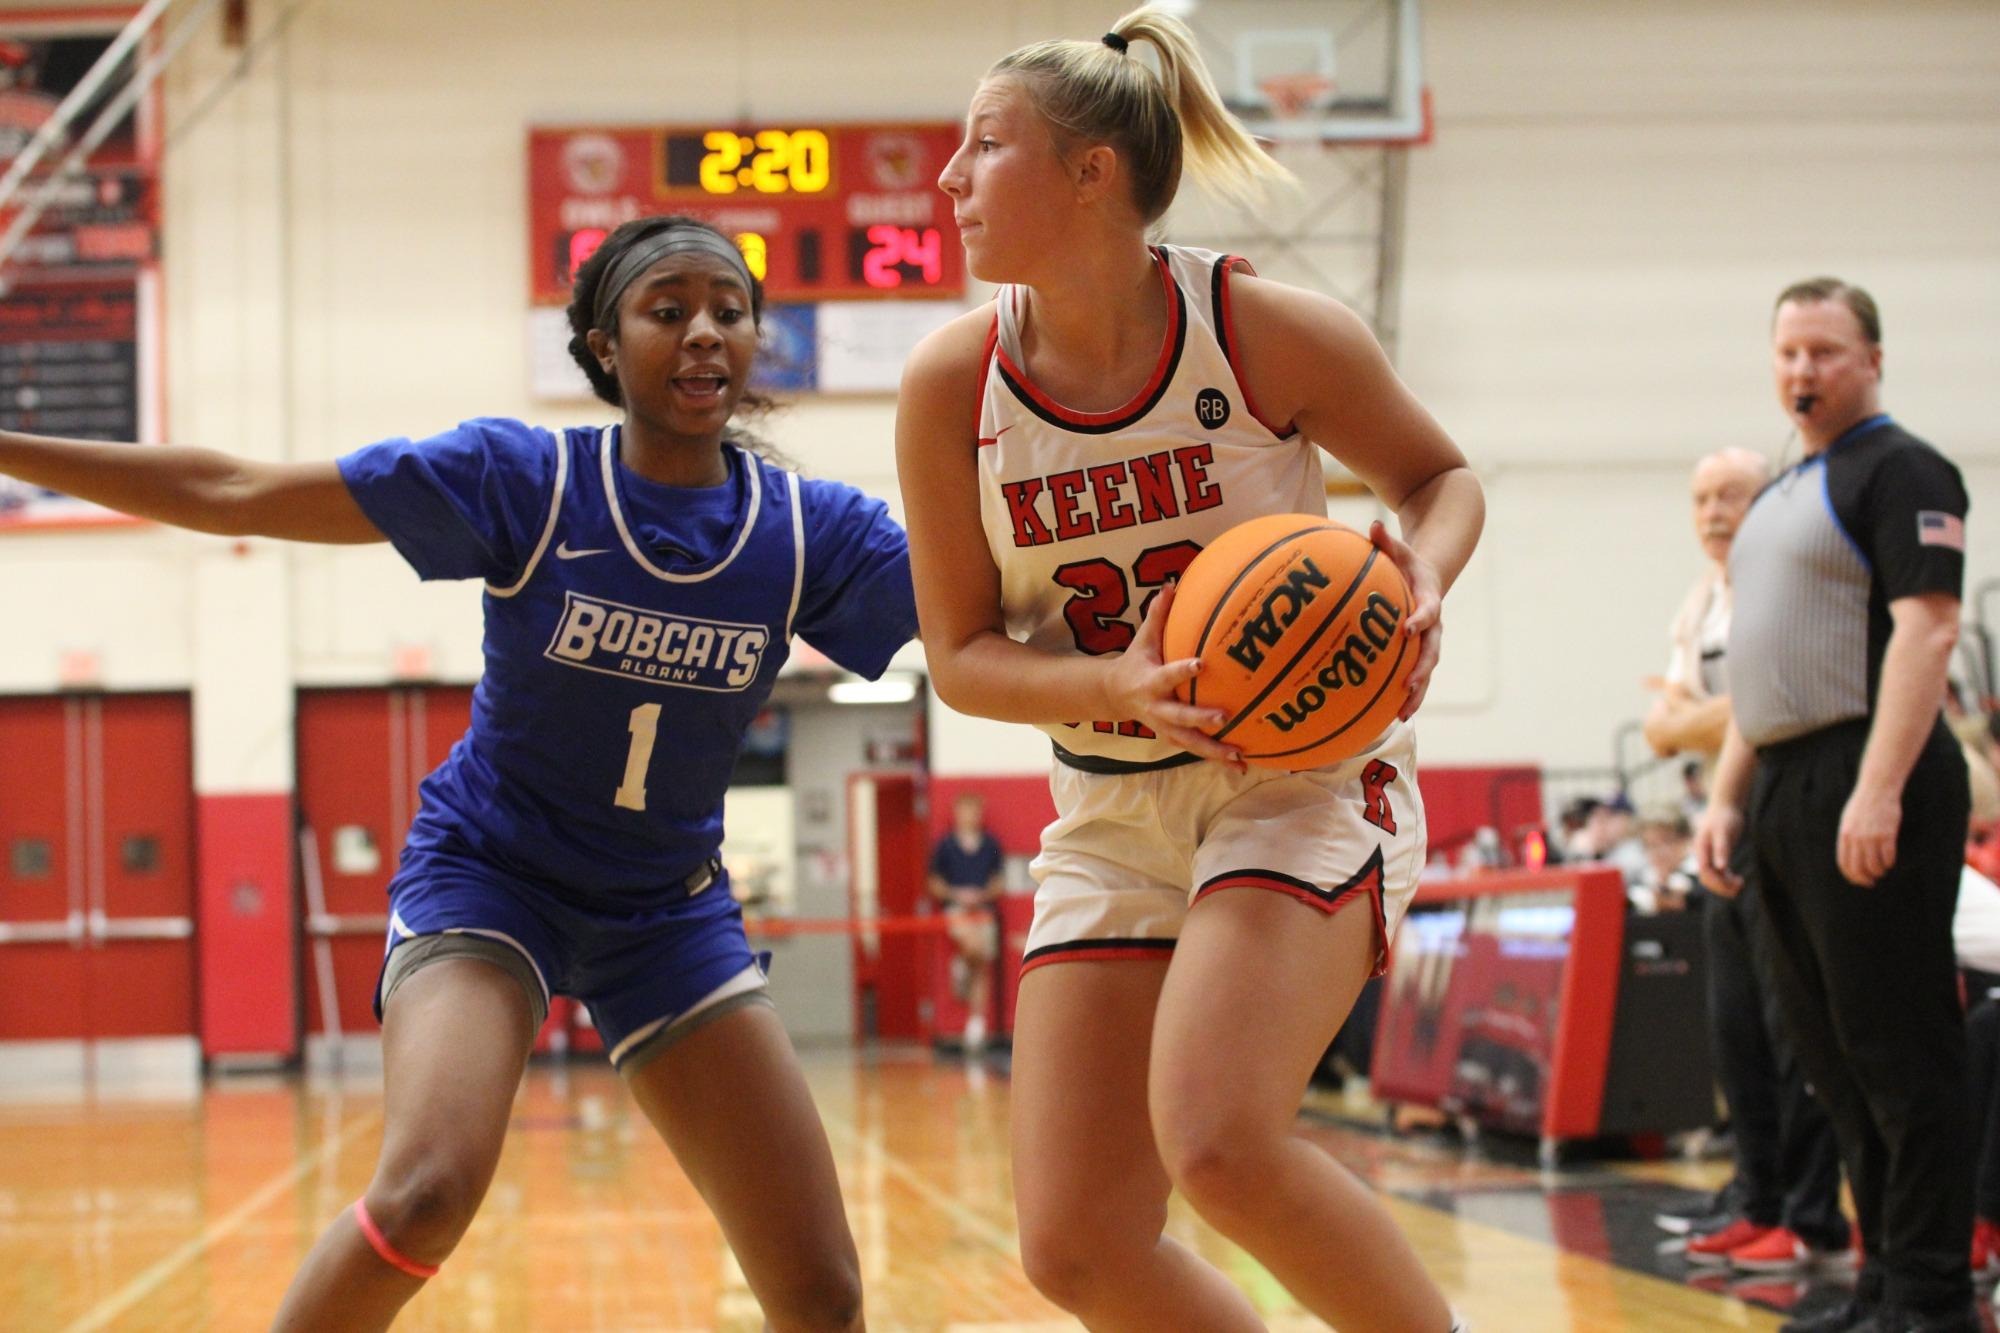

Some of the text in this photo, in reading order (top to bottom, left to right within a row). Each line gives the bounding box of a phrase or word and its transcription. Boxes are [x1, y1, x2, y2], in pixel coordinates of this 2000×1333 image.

[701, 130, 829, 193] 2:20
[864, 225, 941, 288] 24
[1199, 398, 1225, 420] RB
[1001, 443, 1223, 547] KEENE
[553, 599, 767, 687] BOBCATS
[1226, 556, 1331, 673] NCAA
[620, 658, 698, 682] ALBANY
[1264, 591, 1401, 732] Wilson
[613, 702, 662, 811] 1
